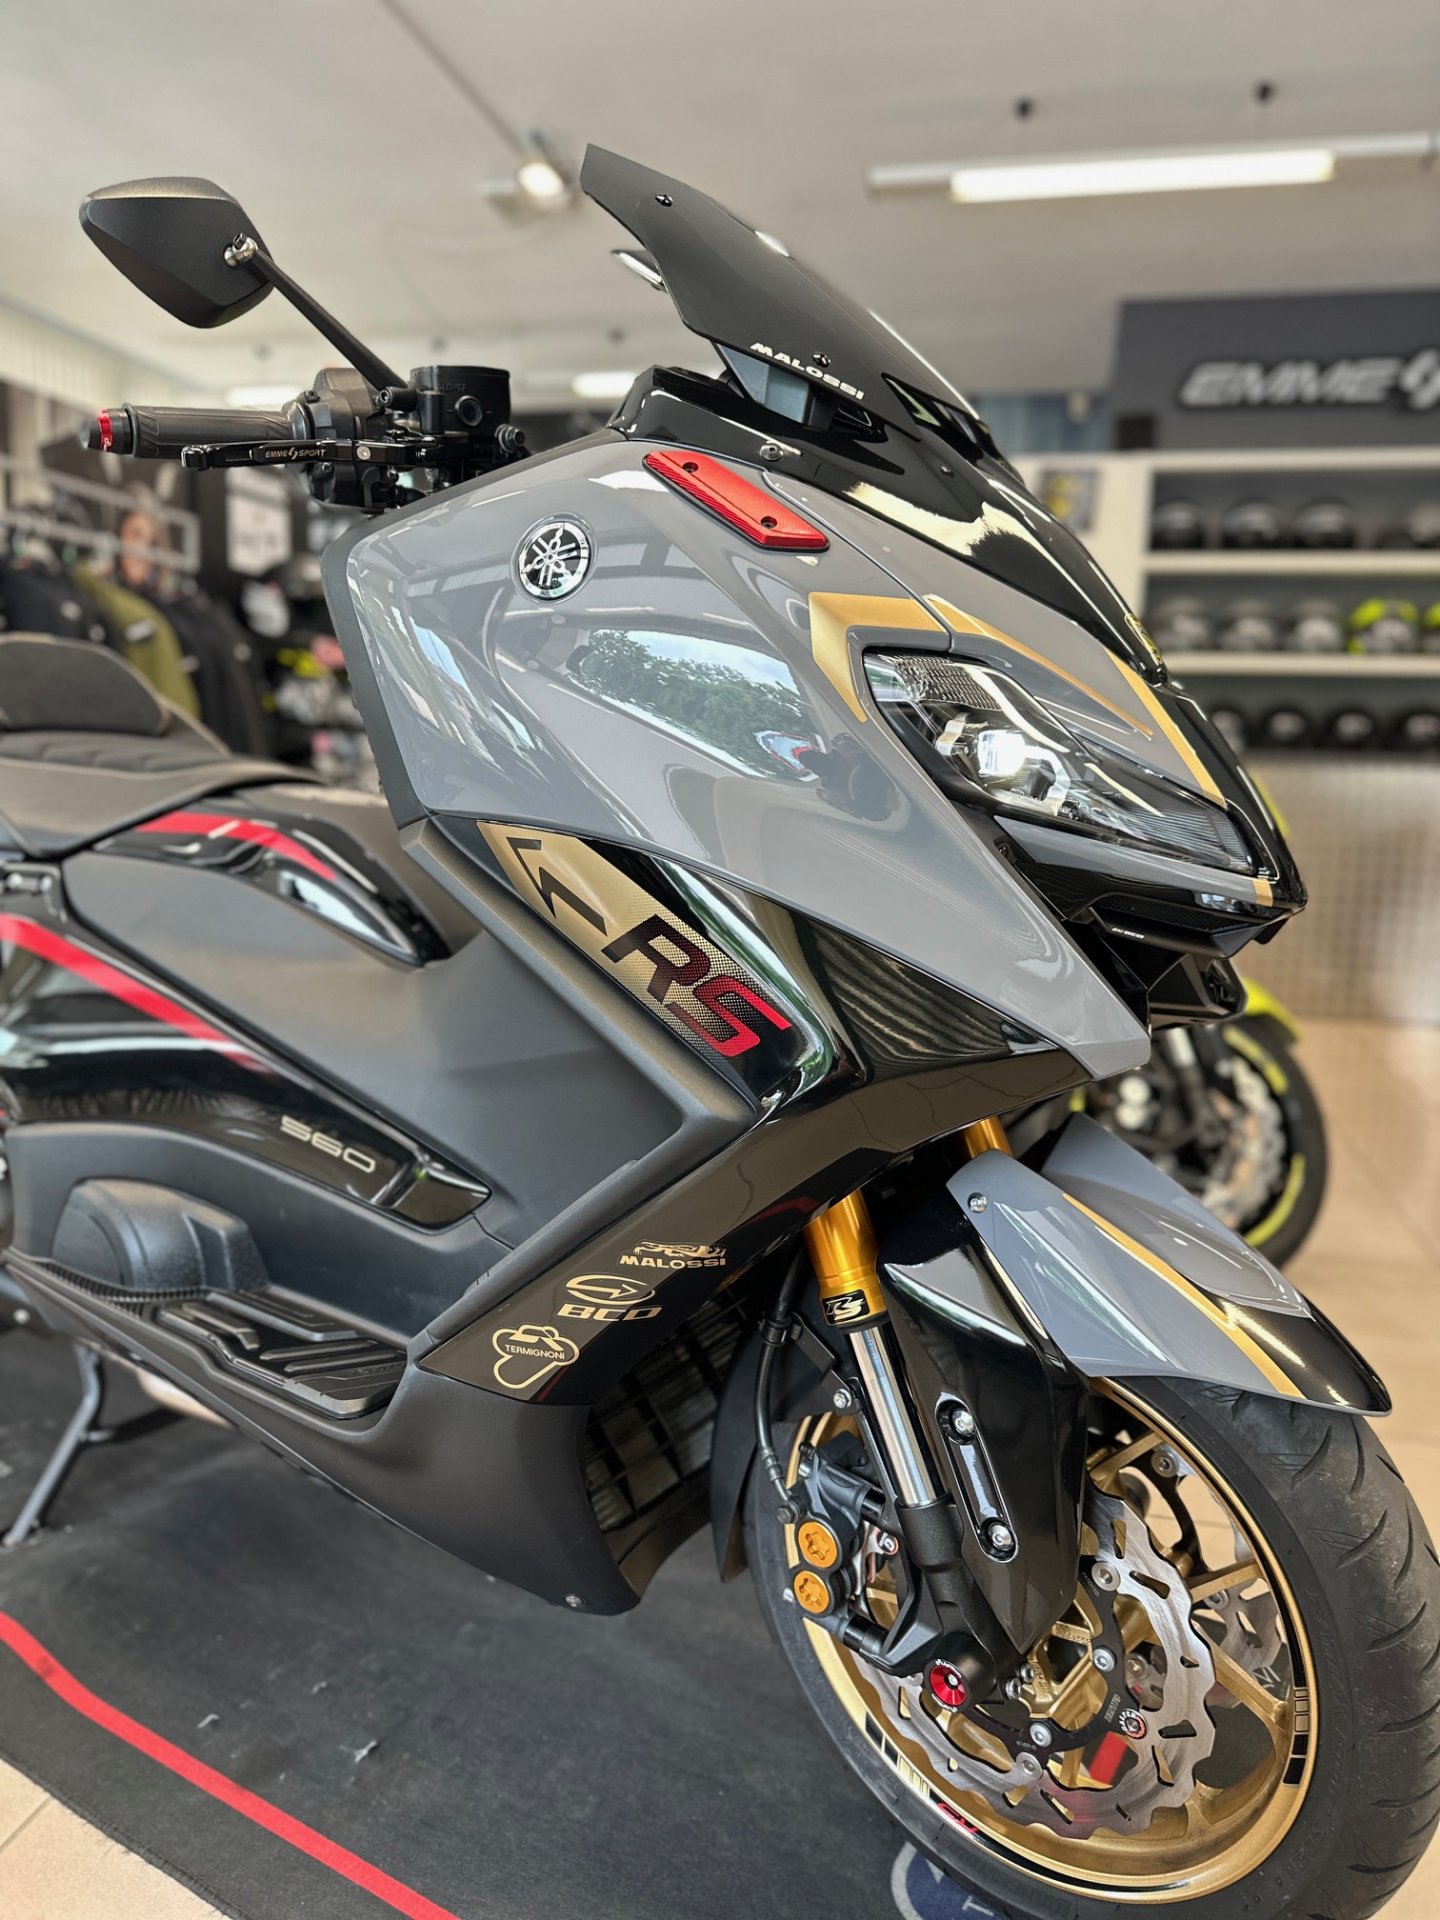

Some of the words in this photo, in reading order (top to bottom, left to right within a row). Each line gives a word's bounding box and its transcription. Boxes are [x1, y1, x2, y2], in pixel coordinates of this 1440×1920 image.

[749, 342, 865, 400] MALOSSI
[265, 450, 288, 459] EMME
[298, 449, 326, 457] SPORT
[600, 913, 793, 1057] RS
[280, 1114, 377, 1174] 560
[619, 1254, 727, 1270] MALOSSI
[556, 1303, 663, 1322] BCD
[504, 1344, 565, 1360] TERMIGNONI
